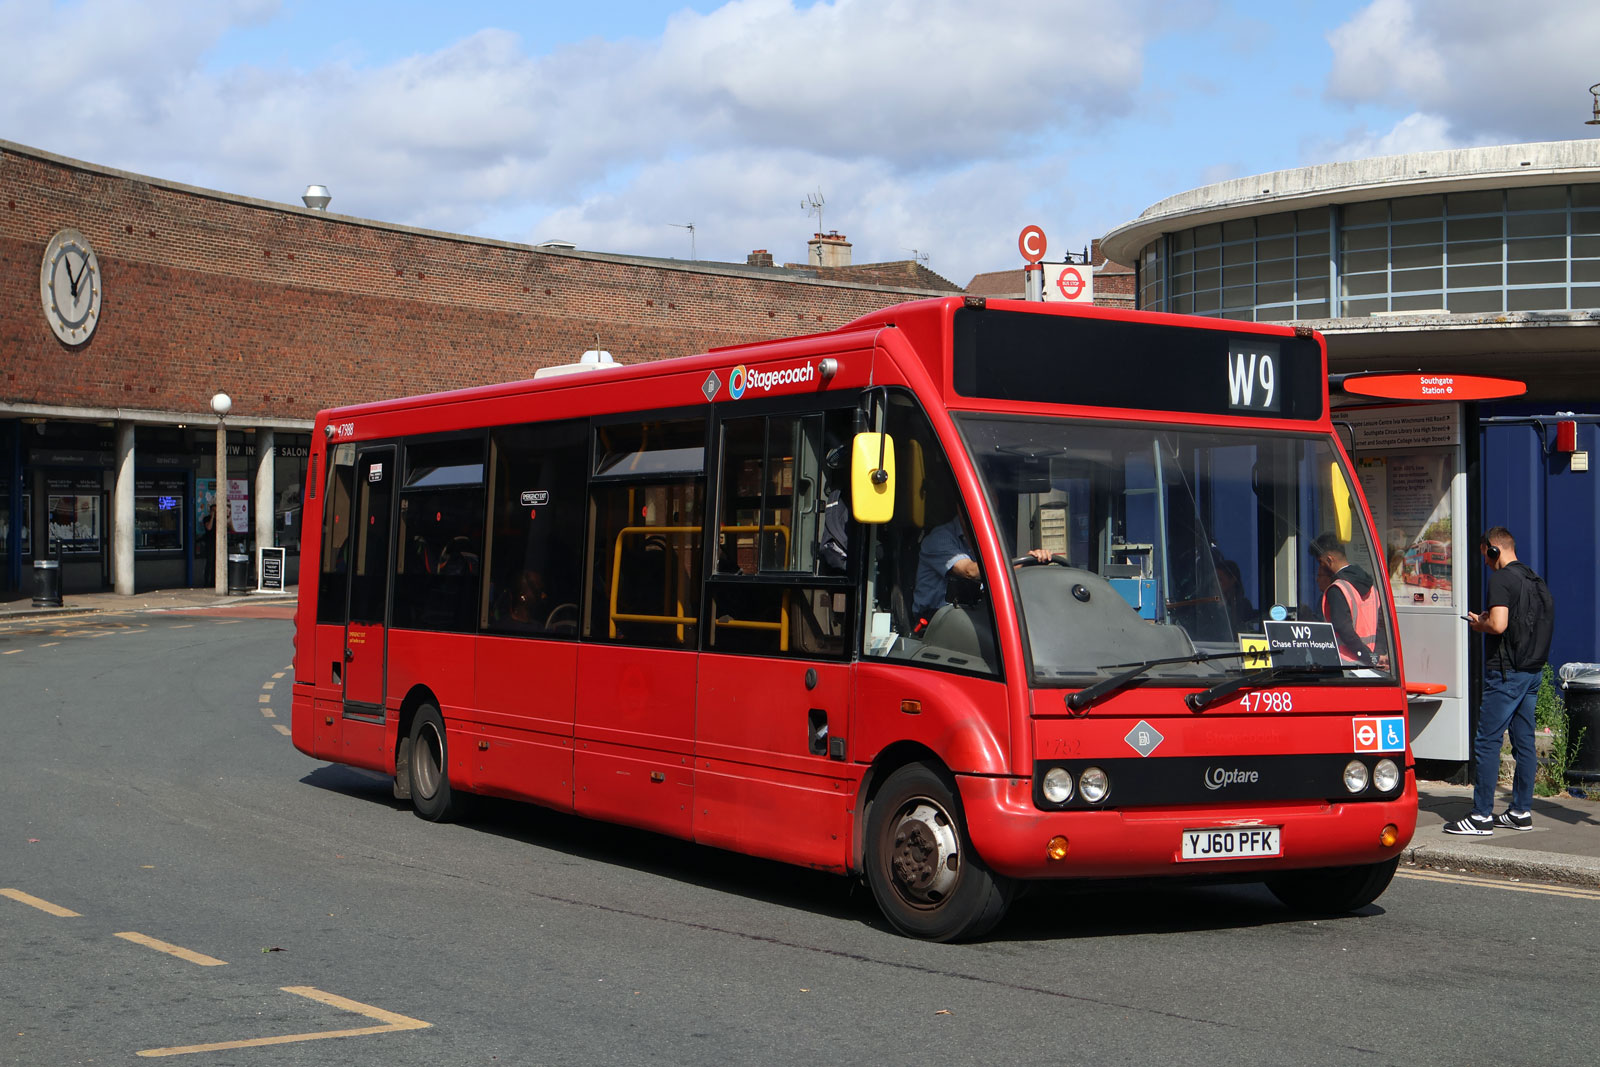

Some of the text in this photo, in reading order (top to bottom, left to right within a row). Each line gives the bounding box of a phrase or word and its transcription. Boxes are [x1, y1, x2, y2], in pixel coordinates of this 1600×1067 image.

[1024, 231, 1040, 255] C
[746, 360, 814, 391] Stagecoach
[1228, 351, 1274, 407] W9
[1420, 376, 1453, 386] Southgate
[1422, 386, 1445, 394] Station
[337, 422, 355, 437] 47988
[1363, 429, 1385, 437] Southgate
[1398, 427, 1413, 435] Library
[1421, 426, 1431, 434] High
[1375, 438, 1396, 446] Southgate
[1397, 437, 1412, 445] College
[281, 447, 308, 457] SALON
[1290, 626, 1311, 639] W9
[1271, 640, 1292, 648] Chase
[1310, 641, 1335, 650] Hospital
[1240, 691, 1293, 712] 47988
[1211, 767, 1259, 788] Optare
[1189, 831, 1272, 854] YJ60 PFK
